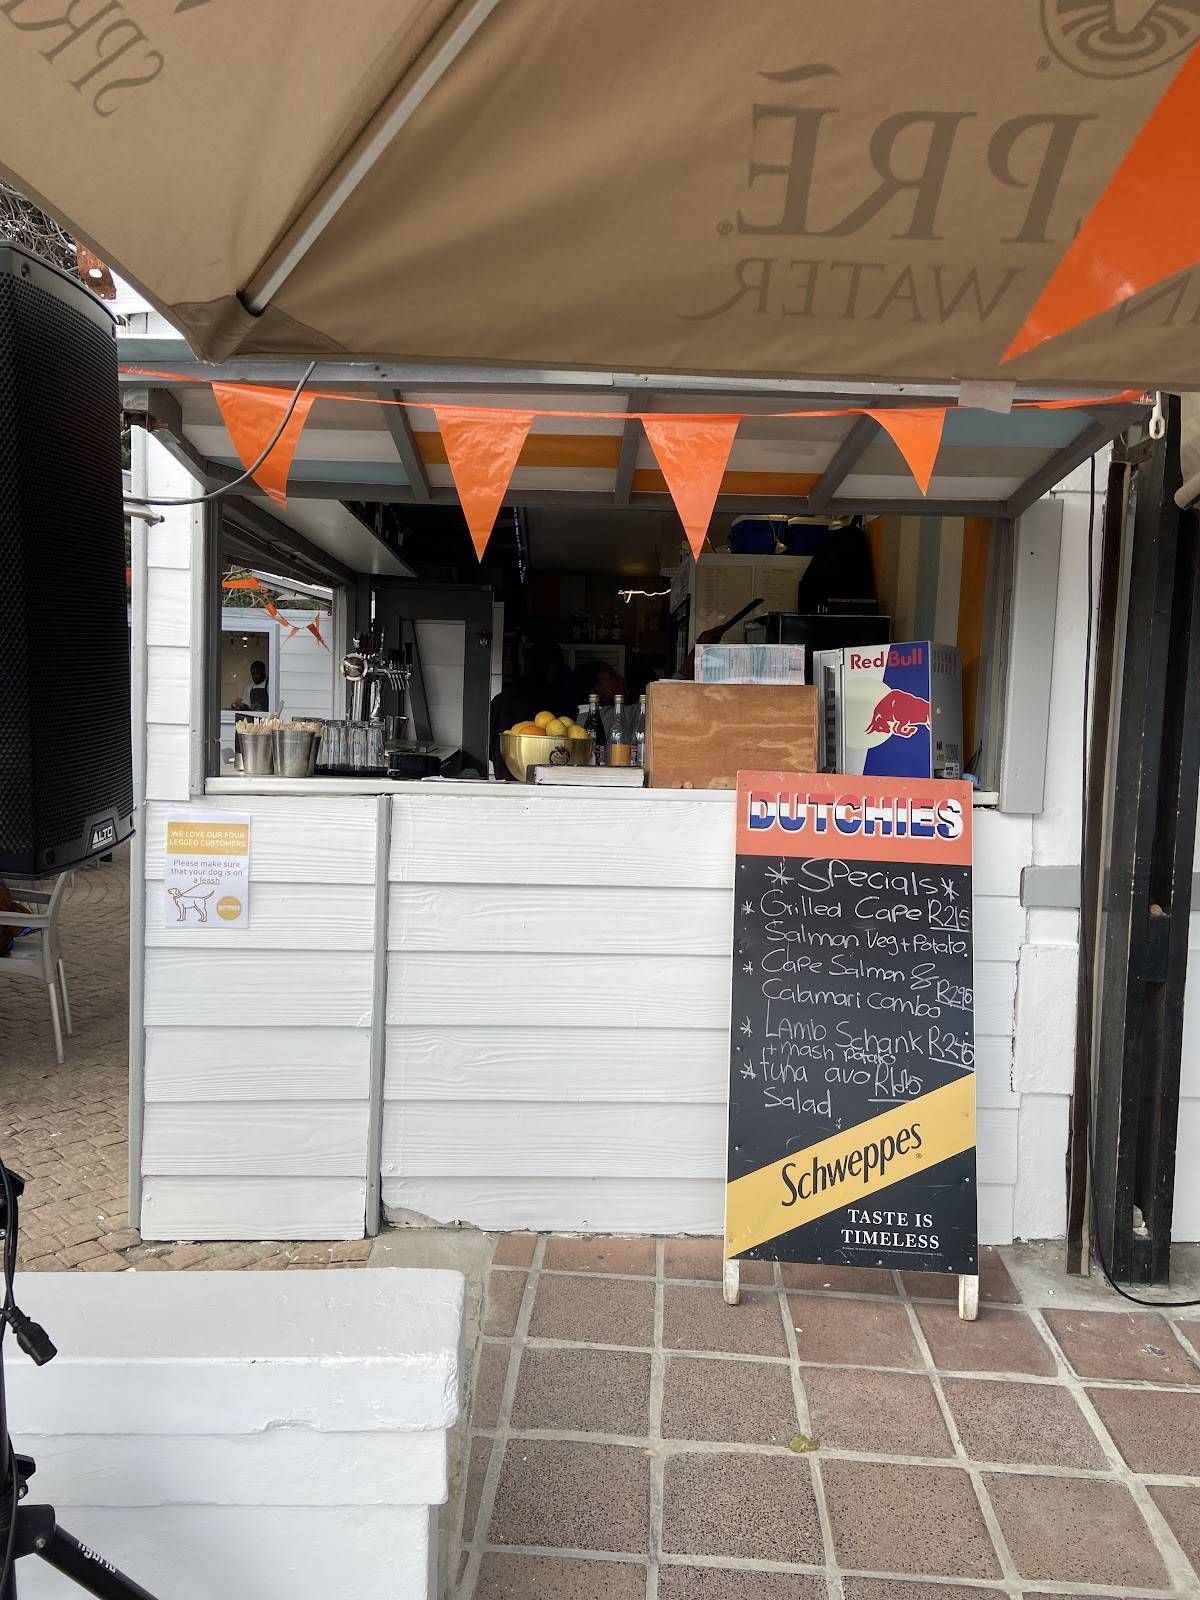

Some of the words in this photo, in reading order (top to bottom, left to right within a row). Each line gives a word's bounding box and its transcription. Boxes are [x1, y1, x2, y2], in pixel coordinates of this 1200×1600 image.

[850, 651, 885, 670] Red
[887, 648, 924, 668] Bull
[748, 790, 964, 841] DUTCHIES
[169, 838, 199, 847] LEGGED
[200, 839, 247, 848] CUSTOMERS
[171, 830, 184, 838] WE
[185, 830, 205, 838] LOVE
[206, 831, 223, 839] OUR
[224, 832, 245, 840] FOUR
[170, 867, 187, 876] that
[188, 868, 206, 877] your
[208, 868, 223, 878] dog
[224, 869, 231, 877] is
[232, 870, 243, 878] on
[173, 859, 199, 868] Please
[200, 860, 222, 869] make
[199, 876, 221, 886] leash
[760, 889, 842, 918] Grilled
[855, 896, 923, 923] Cape
[927, 898, 970, 930] R215
[764, 919, 860, 949] Salmon
[761, 948, 823, 974] Cape
[828, 954, 906, 982] Salmon
[761, 978, 862, 1009] Calamari
[834, 1020, 923, 1055] Schank
[824, 1066, 872, 1085] avo
[763, 1086, 832, 1118] Salad
[780, 1122, 923, 1207] Schweppes
[847, 1208, 909, 1227] TASTE
[914, 1213, 933, 1229] IS
[840, 1228, 941, 1250] TIMELESS
